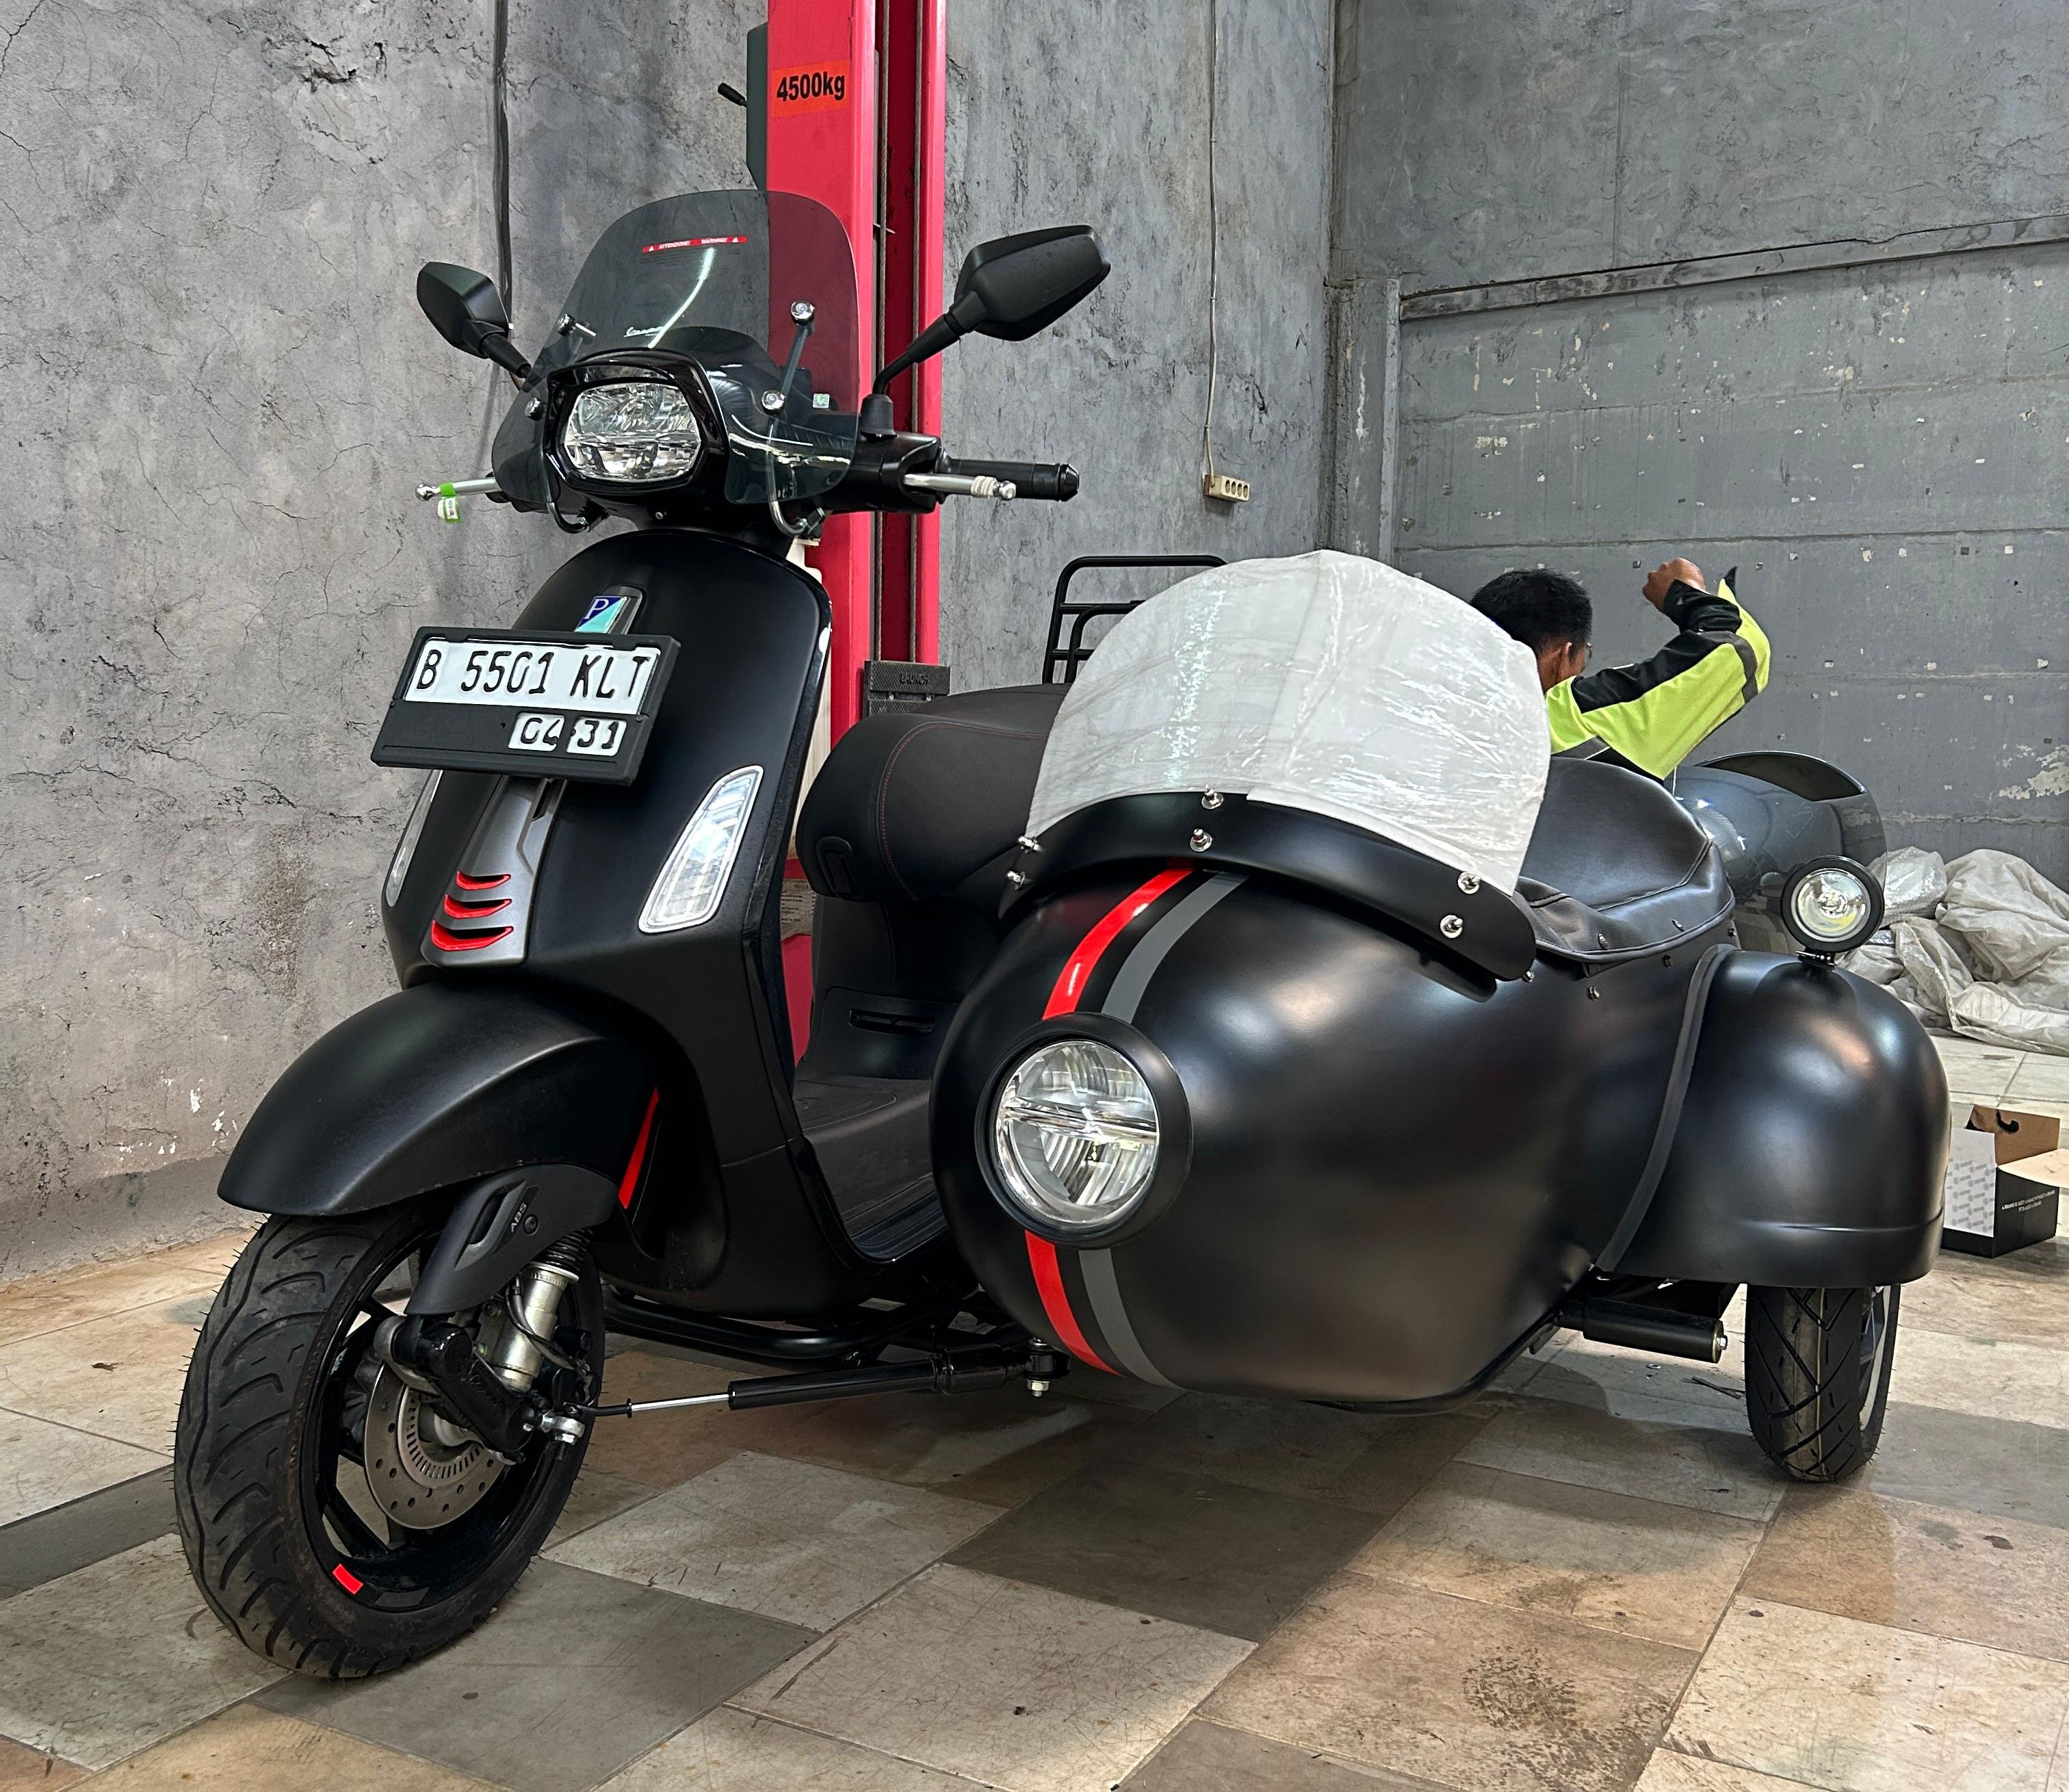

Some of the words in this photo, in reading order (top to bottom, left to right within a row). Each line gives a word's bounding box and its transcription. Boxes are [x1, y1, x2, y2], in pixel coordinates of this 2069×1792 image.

[777, 71, 846, 101] 4500kg
[585, 597, 610, 619] P
[416, 649, 442, 690] B
[460, 650, 555, 694] 5501
[570, 654, 651, 699] KLT
[510, 1202, 527, 1233] ABS
